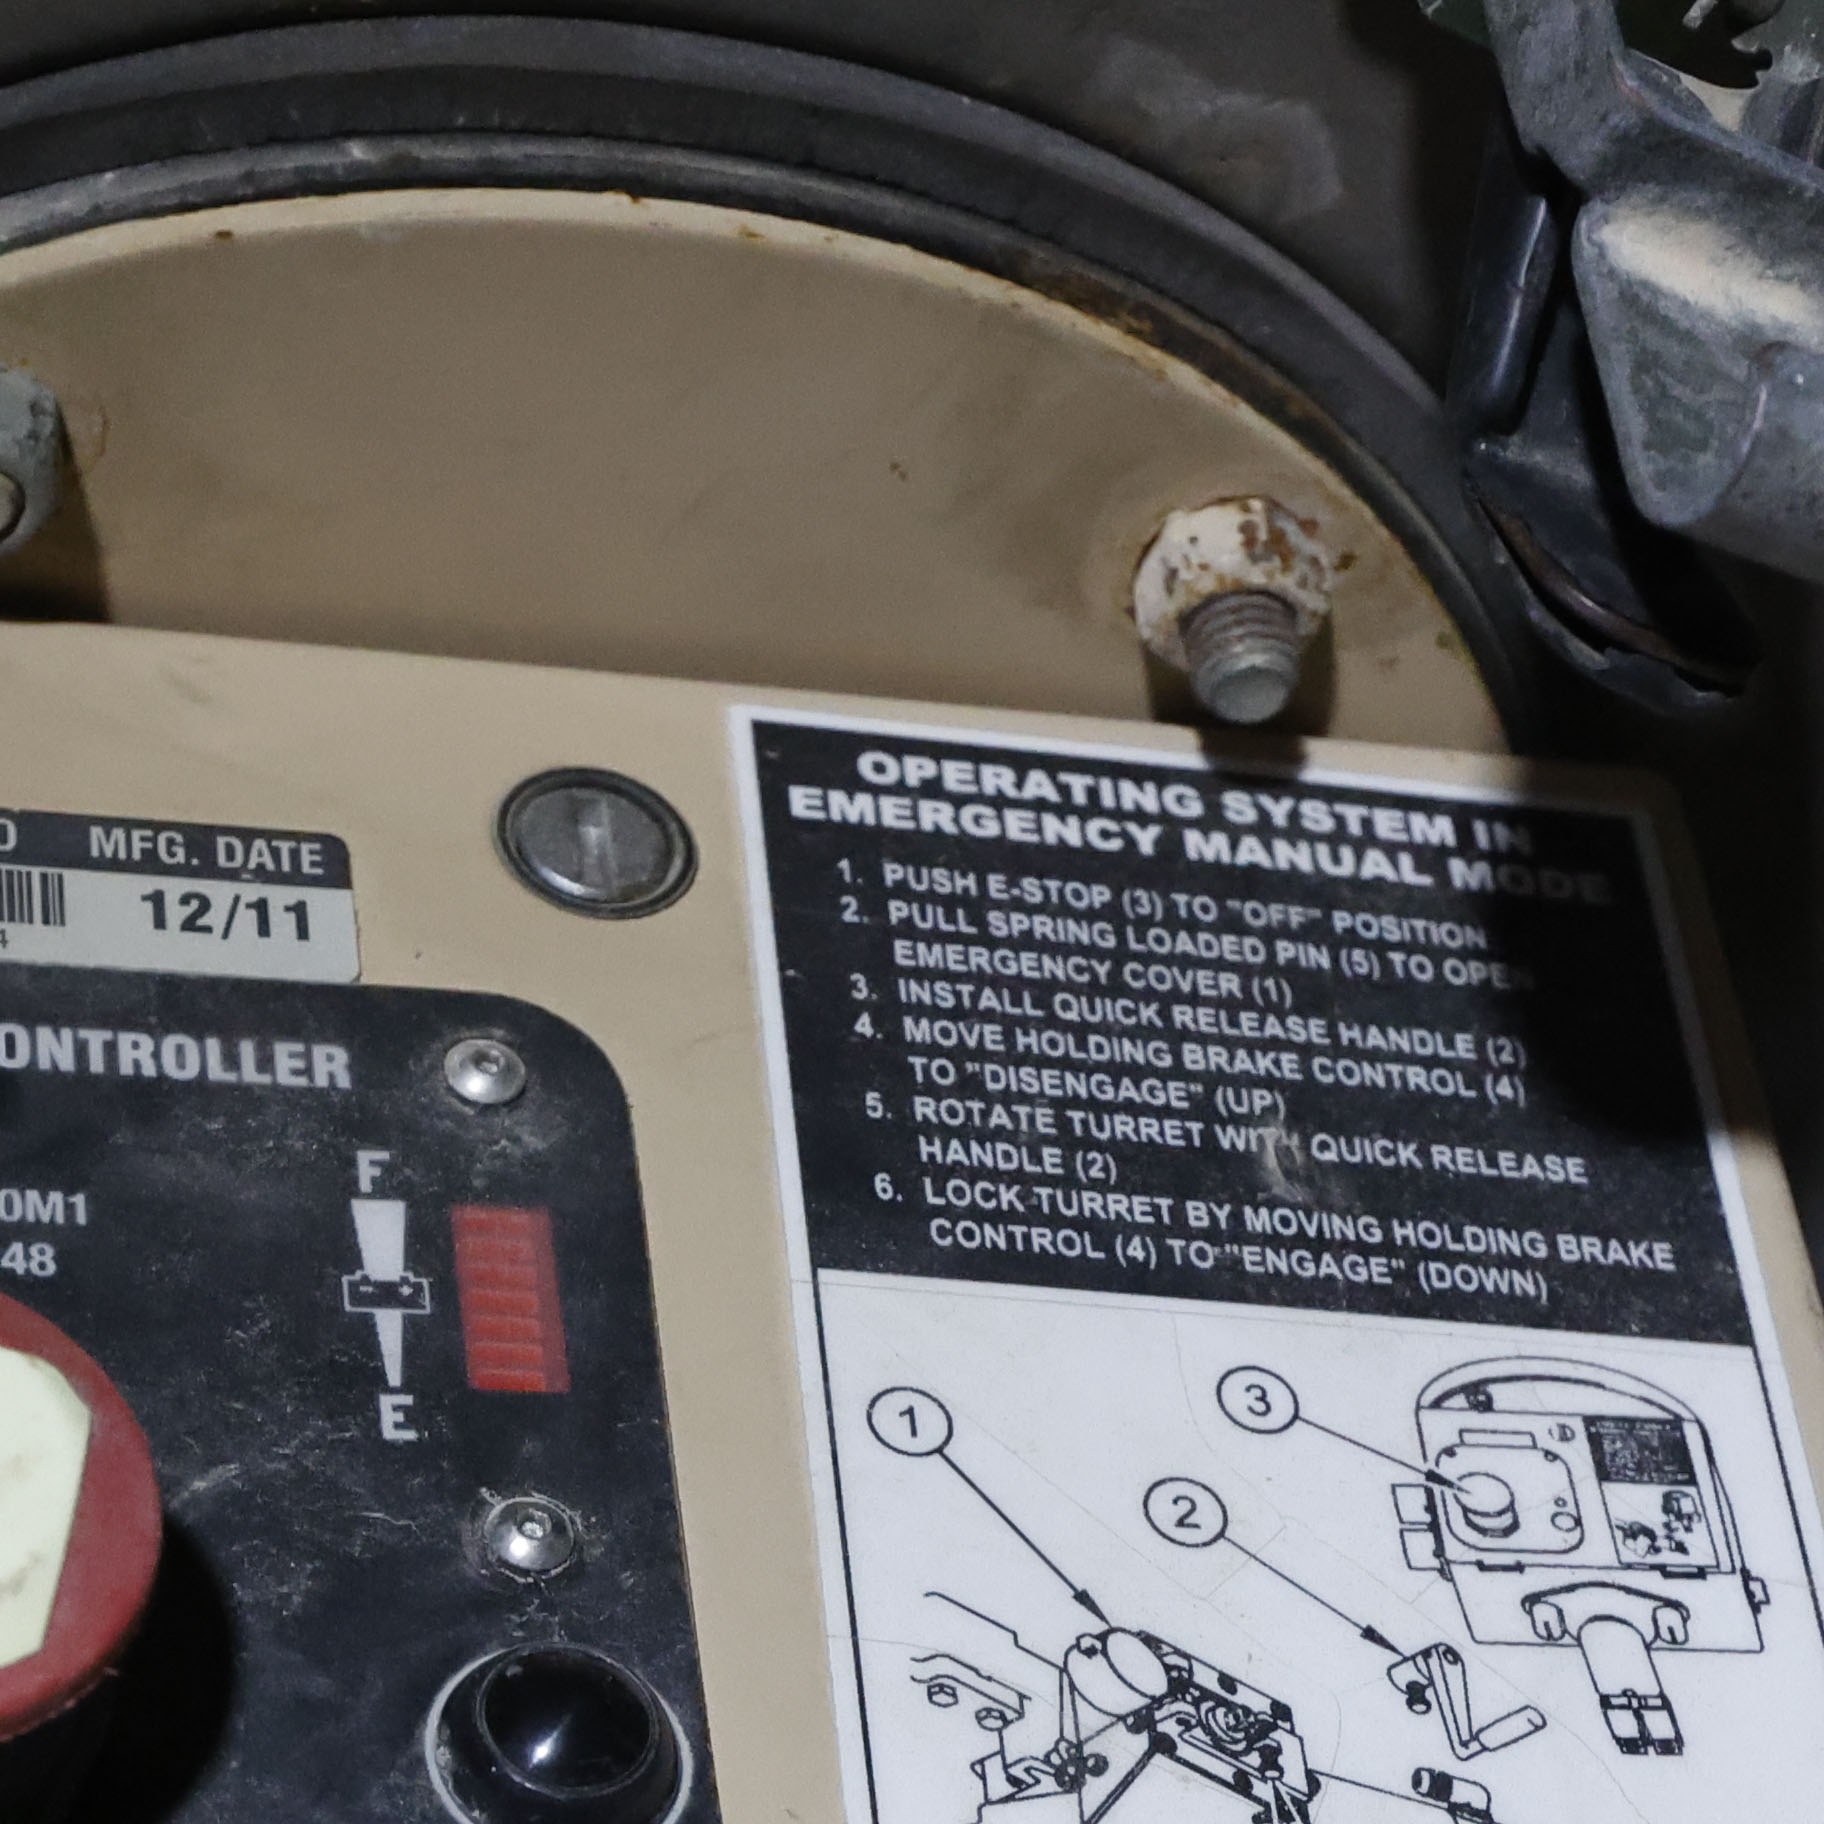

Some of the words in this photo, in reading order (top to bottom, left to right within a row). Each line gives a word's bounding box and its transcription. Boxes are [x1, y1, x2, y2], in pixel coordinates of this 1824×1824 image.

[857, 750, 1204, 818] OPERATING
[1220, 790, 1457, 848] SYSTEM
[1472, 819, 1534, 857] IN
[90, 825, 199, 868] MFG.
[217, 836, 323, 875] DATE
[788, 784, 1163, 856] EMERGENCY
[1182, 828, 1433, 887] MANUAL
[1447, 855, 1612, 905] MODE
[141, 890, 311, 941] 12/11
[837, 858, 863, 884] 1.
[882, 861, 976, 897] PUSH
[987, 872, 1112, 909] E-STOP
[1122, 888, 1163, 921] (3)
[1170, 892, 1218, 922] TO
[1225, 899, 1322, 930] "OFF"
[1331, 910, 1488, 950] POSITION
[840, 897, 870, 924] 2.
[888, 899, 977, 934] PULL
[988, 911, 1116, 948] SPRING
[1127, 925, 1266, 964] LOADED
[1275, 940, 1331, 969] PIN
[1339, 948, 1381, 981] (5)
[1388, 952, 1434, 982] TO
[893, 939, 1110, 985] EMERGENCY
[1122, 961, 1243, 1000] COVER
[1251, 975, 1292, 1009] (1)
[850, 973, 877, 1000] 3.
[898, 978, 1044, 1017] INSTALL
[1053, 992, 1164, 1029] QUICK
[1171, 1004, 1330, 1045] RELEASE
[1338, 1020, 1476, 1060] HANDLE
[1486, 1035, 1527, 1070] (2)
[853, 1012, 882, 1039] 4.
[903, 1016, 1005, 1051] MOVE
[1016, 1028, 1172, 1068] HOLDING
[1182, 1043, 1303, 1081] BRAKE
[1311, 1056, 1476, 1098] CONTROL
[1485, 1074, 1526, 1109] (4)
[908, 1056, 956, 1086] TO
[965, 1060, 1203, 1109] "DISENGAGE"
[1216, 1086, 1286, 1122] (UP)
[357, 1150, 390, 1192] F
[865, 1092, 892, 1120] 5.
[913, 1096, 1057, 1134] ROTATE
[1066, 1110, 1204, 1148] TURRET
[1310, 1132, 1422, 1170] QUICK
[1431, 1144, 1590, 1185] RELEASE
[918, 1136, 1064, 1175] HANDLE
[1076, 1152, 1116, 1186] (2)
[874, 1173, 902, 1201] 6.
[922, 1177, 1023, 1212] LOCK
[1034, 1186, 1174, 1225] TURRET
[1186, 1200, 1232, 1231] BY
[1244, 1205, 1382, 1244] MOVING
[1392, 1218, 1548, 1259] HOLDING
[1557, 1233, 1676, 1272] BRAKE
[930, 1218, 1105, 1260] CONTROL
[1116, 1234, 1156, 1270] (4)
[1166, 1238, 1215, 1269] TO
[1223, 1243, 1405, 1285] "ENGAGE"
[1418, 1260, 1548, 1305] (DOWN)
[379, 1394, 418, 1441] E
[900, 1405, 919, 1438] 1
[1245, 1384, 1272, 1417] 3
[1172, 1495, 1201, 1529] 2
